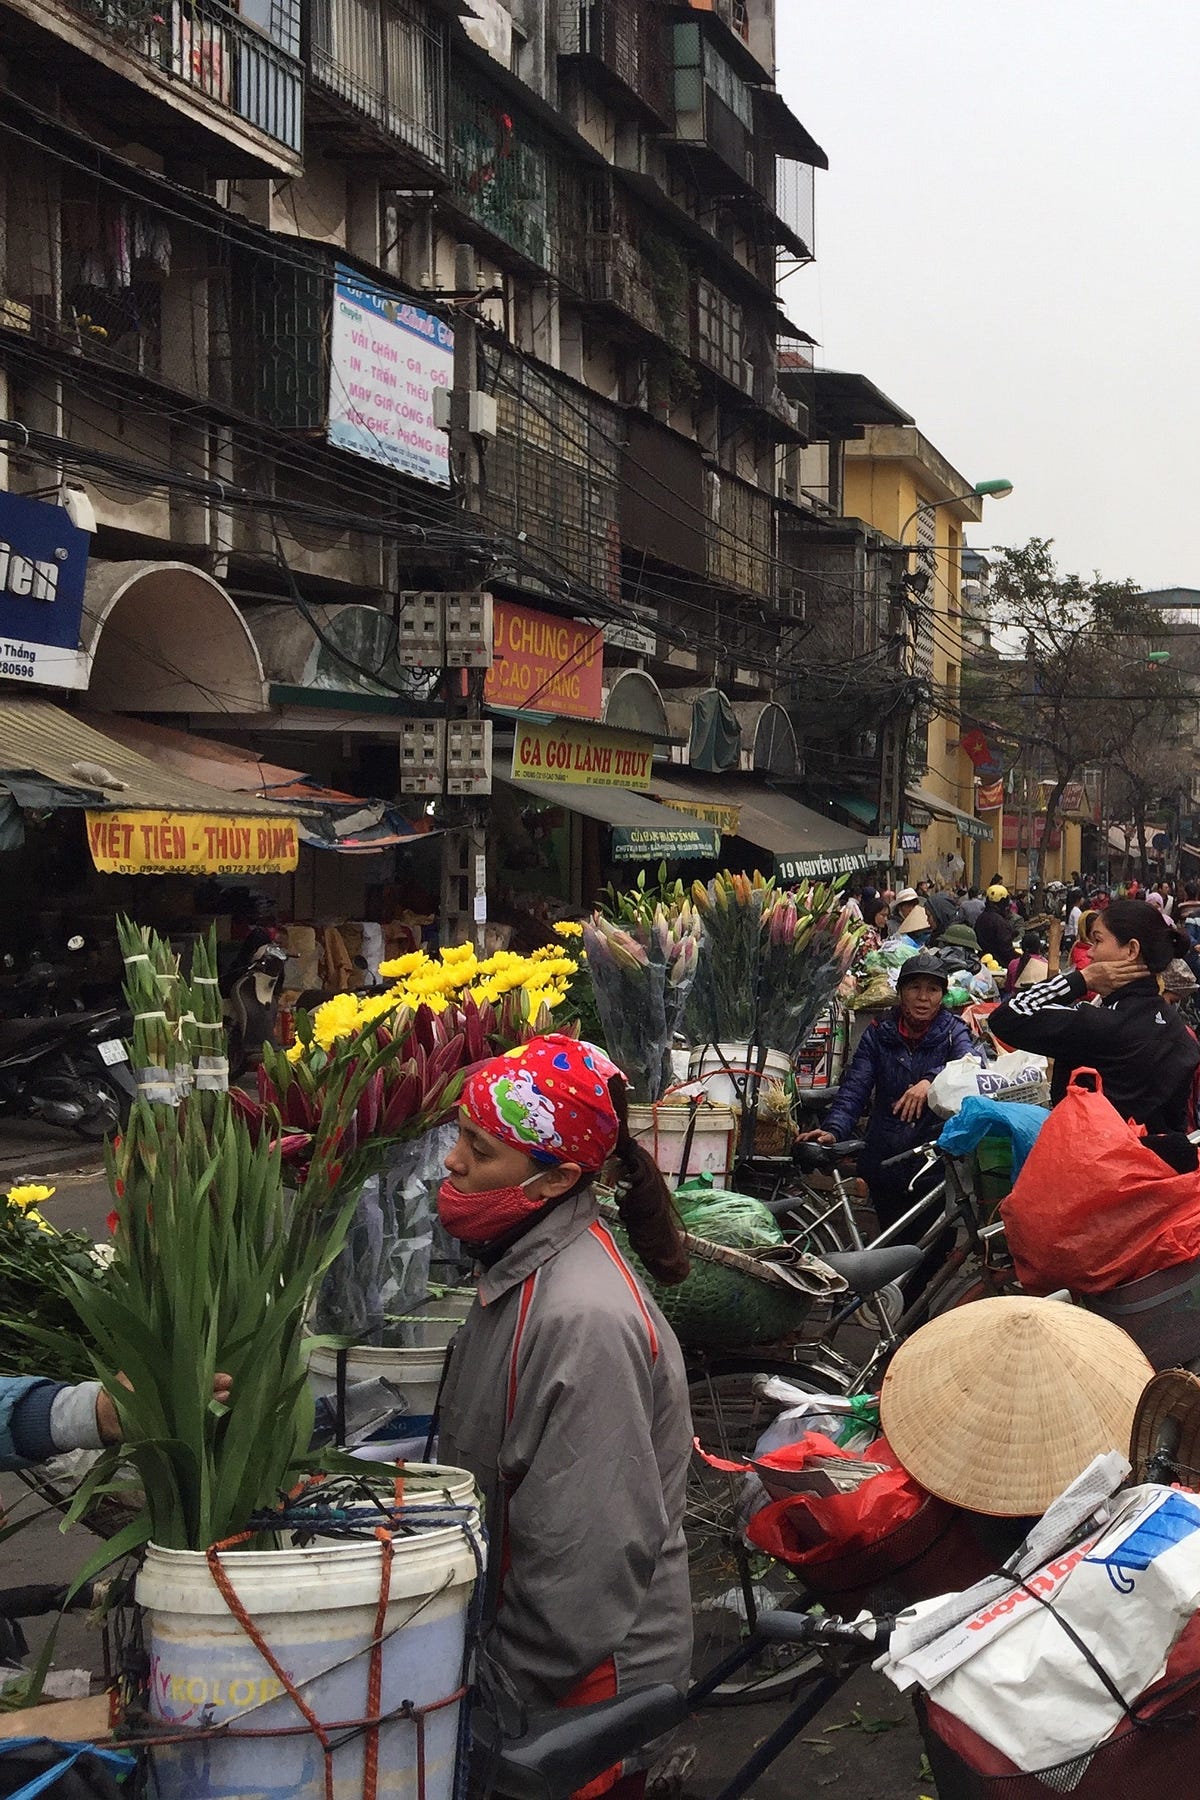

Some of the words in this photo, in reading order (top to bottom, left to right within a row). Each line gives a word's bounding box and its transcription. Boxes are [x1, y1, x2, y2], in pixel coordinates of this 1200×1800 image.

[350, 355, 361, 373] IN
[407, 358, 422, 375] GA
[349, 382, 371, 402] MAY
[375, 395, 392, 411] GIA
[395, 400, 429, 425] CÔNG
[509, 616, 569, 661] CHUNG
[500, 660, 531, 690] CAO
[519, 736, 542, 766] GA
[546, 730, 573, 769] GỐI
[574, 736, 612, 774] LÀNH
[140, 815, 186, 859] TIẾN
[204, 818, 251, 860] THỦY
[779, 861, 795, 879] 19
